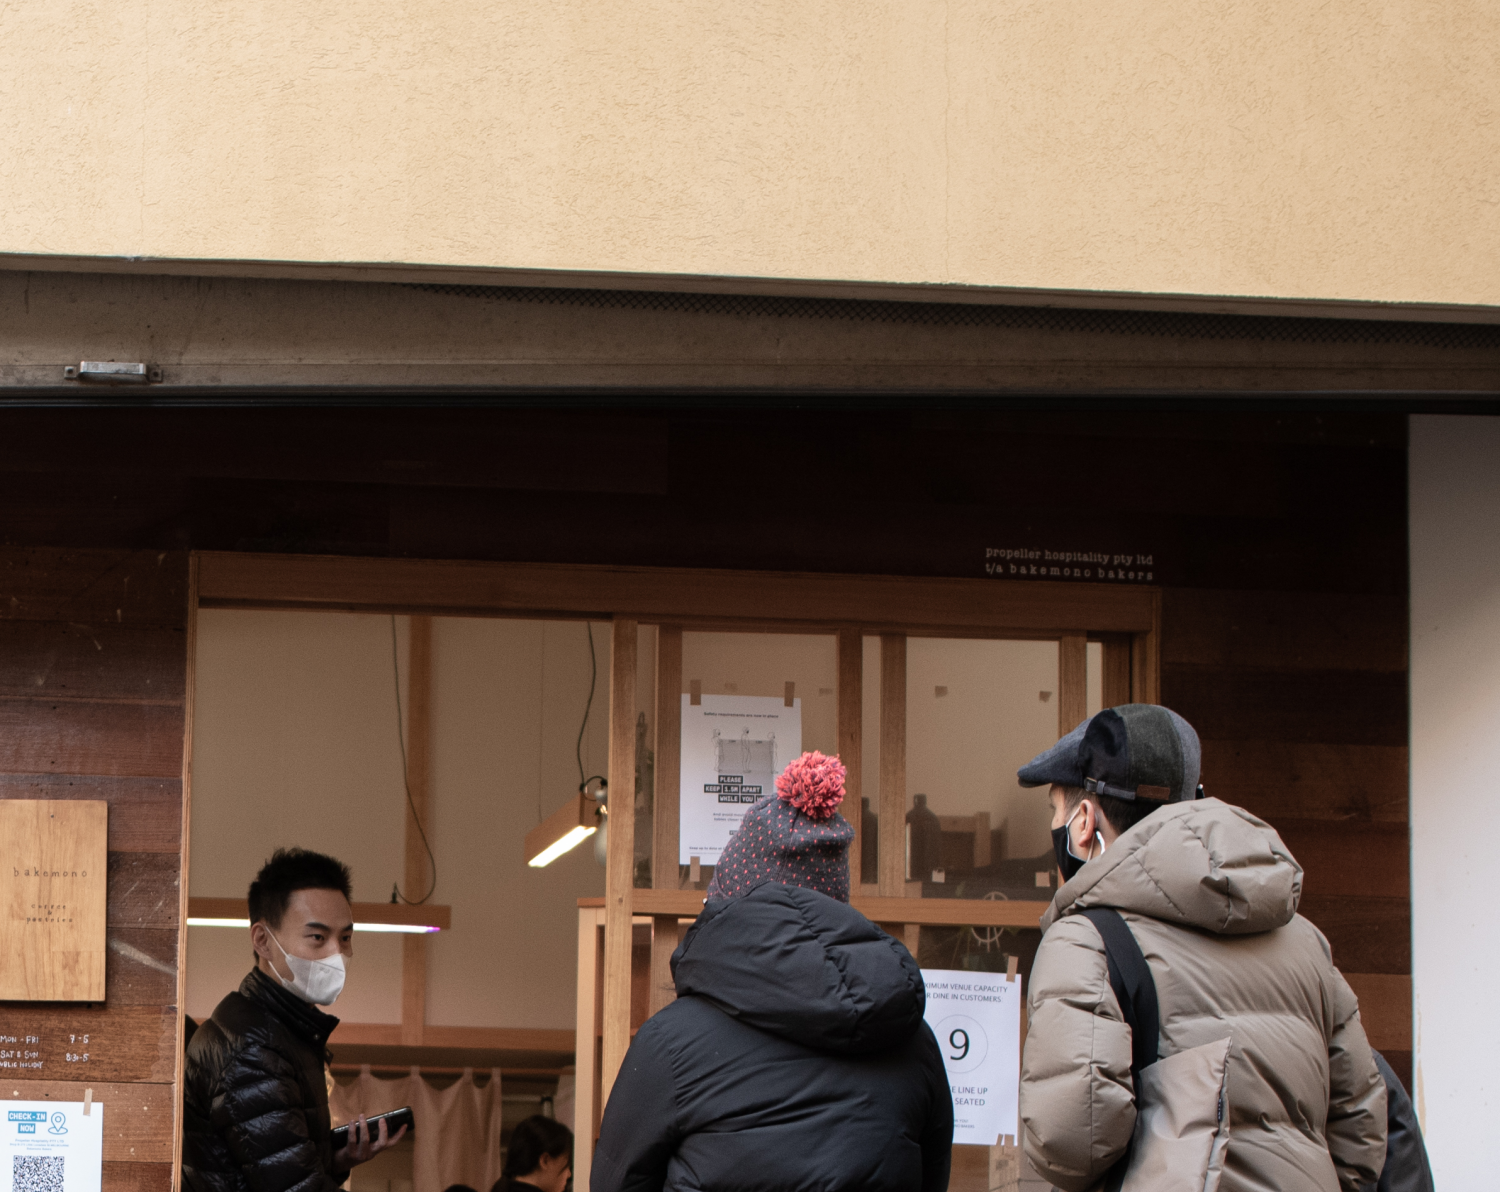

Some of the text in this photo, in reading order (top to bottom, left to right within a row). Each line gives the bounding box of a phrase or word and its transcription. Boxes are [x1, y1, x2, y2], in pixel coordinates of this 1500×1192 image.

[985, 547, 1153, 566] propeller hospitality pty ltd
[985, 562, 1153, 581] t/a bakemono bakers
[13, 866, 88, 878] bakemono
[924, 983, 1008, 994] XIMUM VENUE CAPACITY
[932, 992, 950, 1000] DINE
[0, 1035, 17, 1043] MON
[26, 1035, 39, 1044] FRI
[69, 1034, 76, 1044] 7
[83, 1034, 90, 1044] 5
[949, 1028, 970, 1061] 9
[0, 1050, 15, 1059] SAT
[24, 1050, 39, 1059] SUN
[957, 1086, 976, 1094] LINE
[977, 1087, 988, 1095] UP
[954, 1097, 986, 1107] SEATED
[8, 1112, 46, 1121] CHECK-IN
[20, 1124, 35, 1132] NOW
